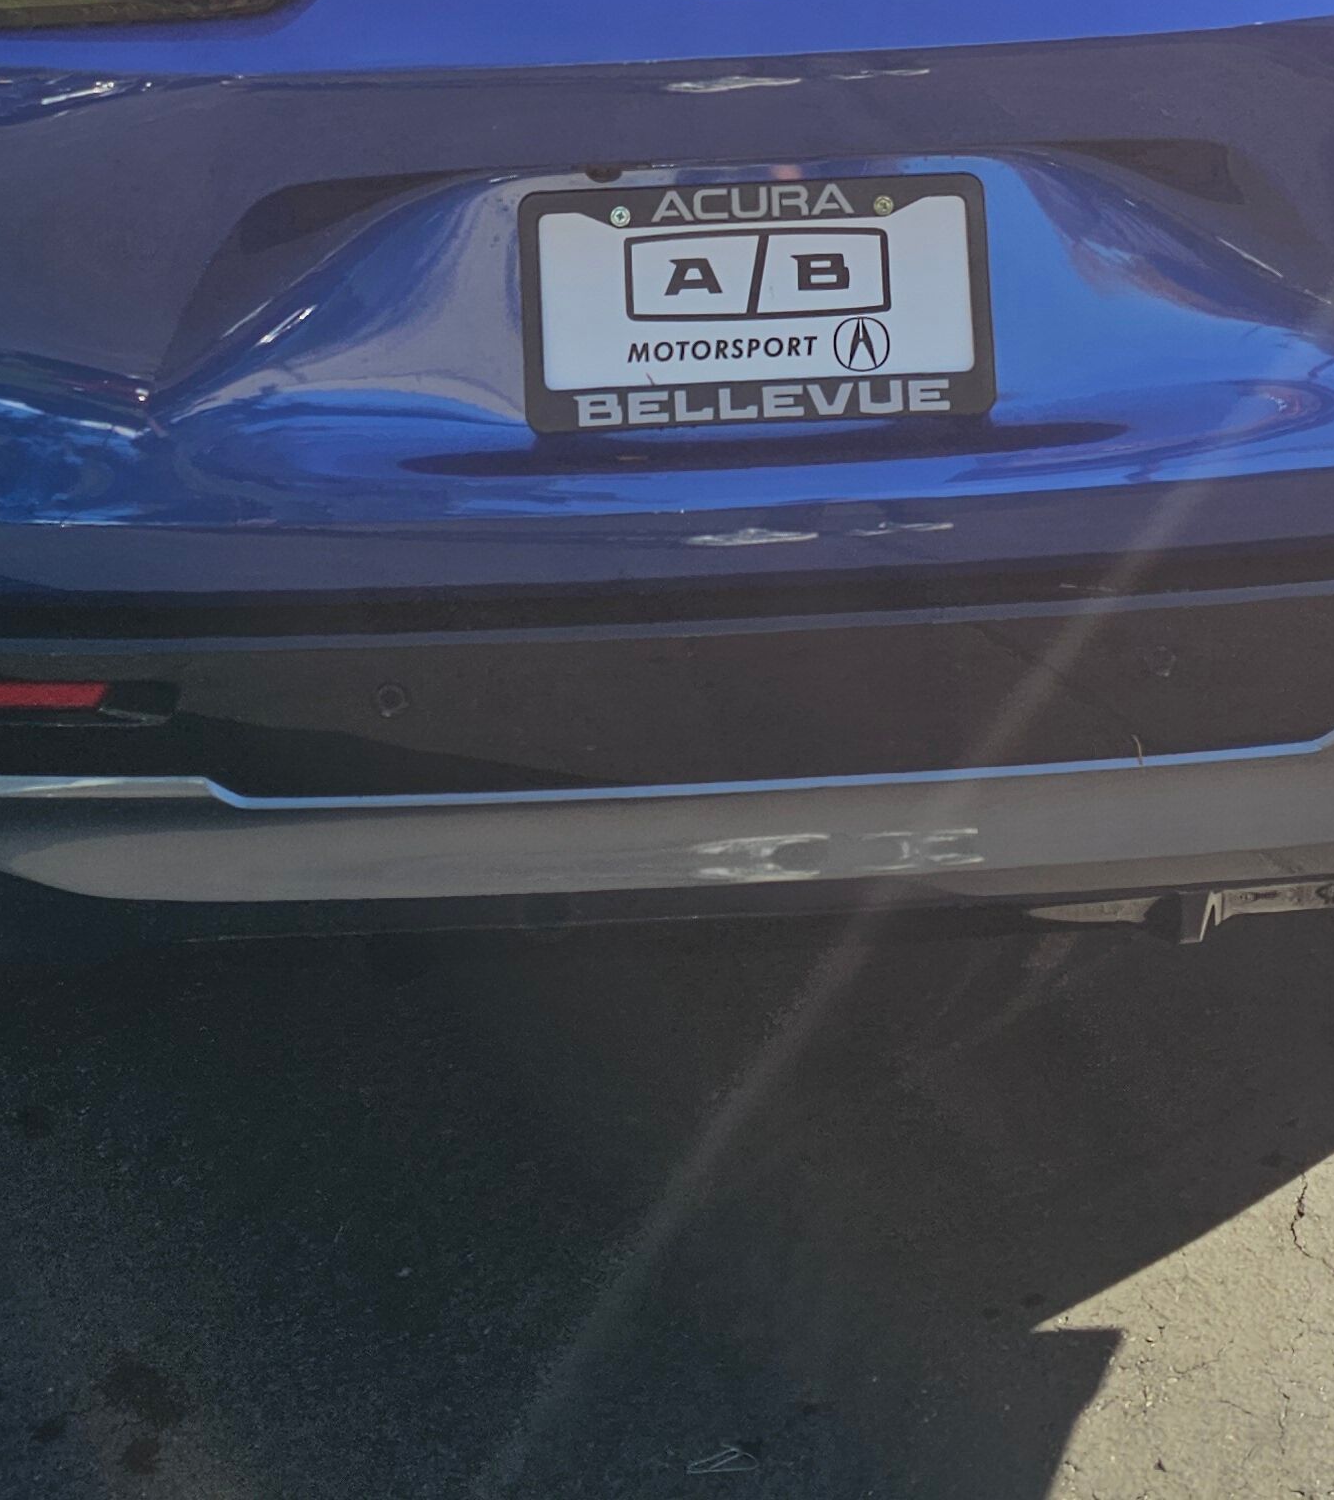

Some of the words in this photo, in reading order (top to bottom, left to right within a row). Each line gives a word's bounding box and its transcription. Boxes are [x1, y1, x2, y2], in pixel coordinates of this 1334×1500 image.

[651, 183, 854, 223] ACURA
[664, 257, 723, 296] A
[790, 253, 850, 291] B
[627, 336, 818, 363] MOTORSPORT
[574, 379, 951, 427] BELLEVUE
